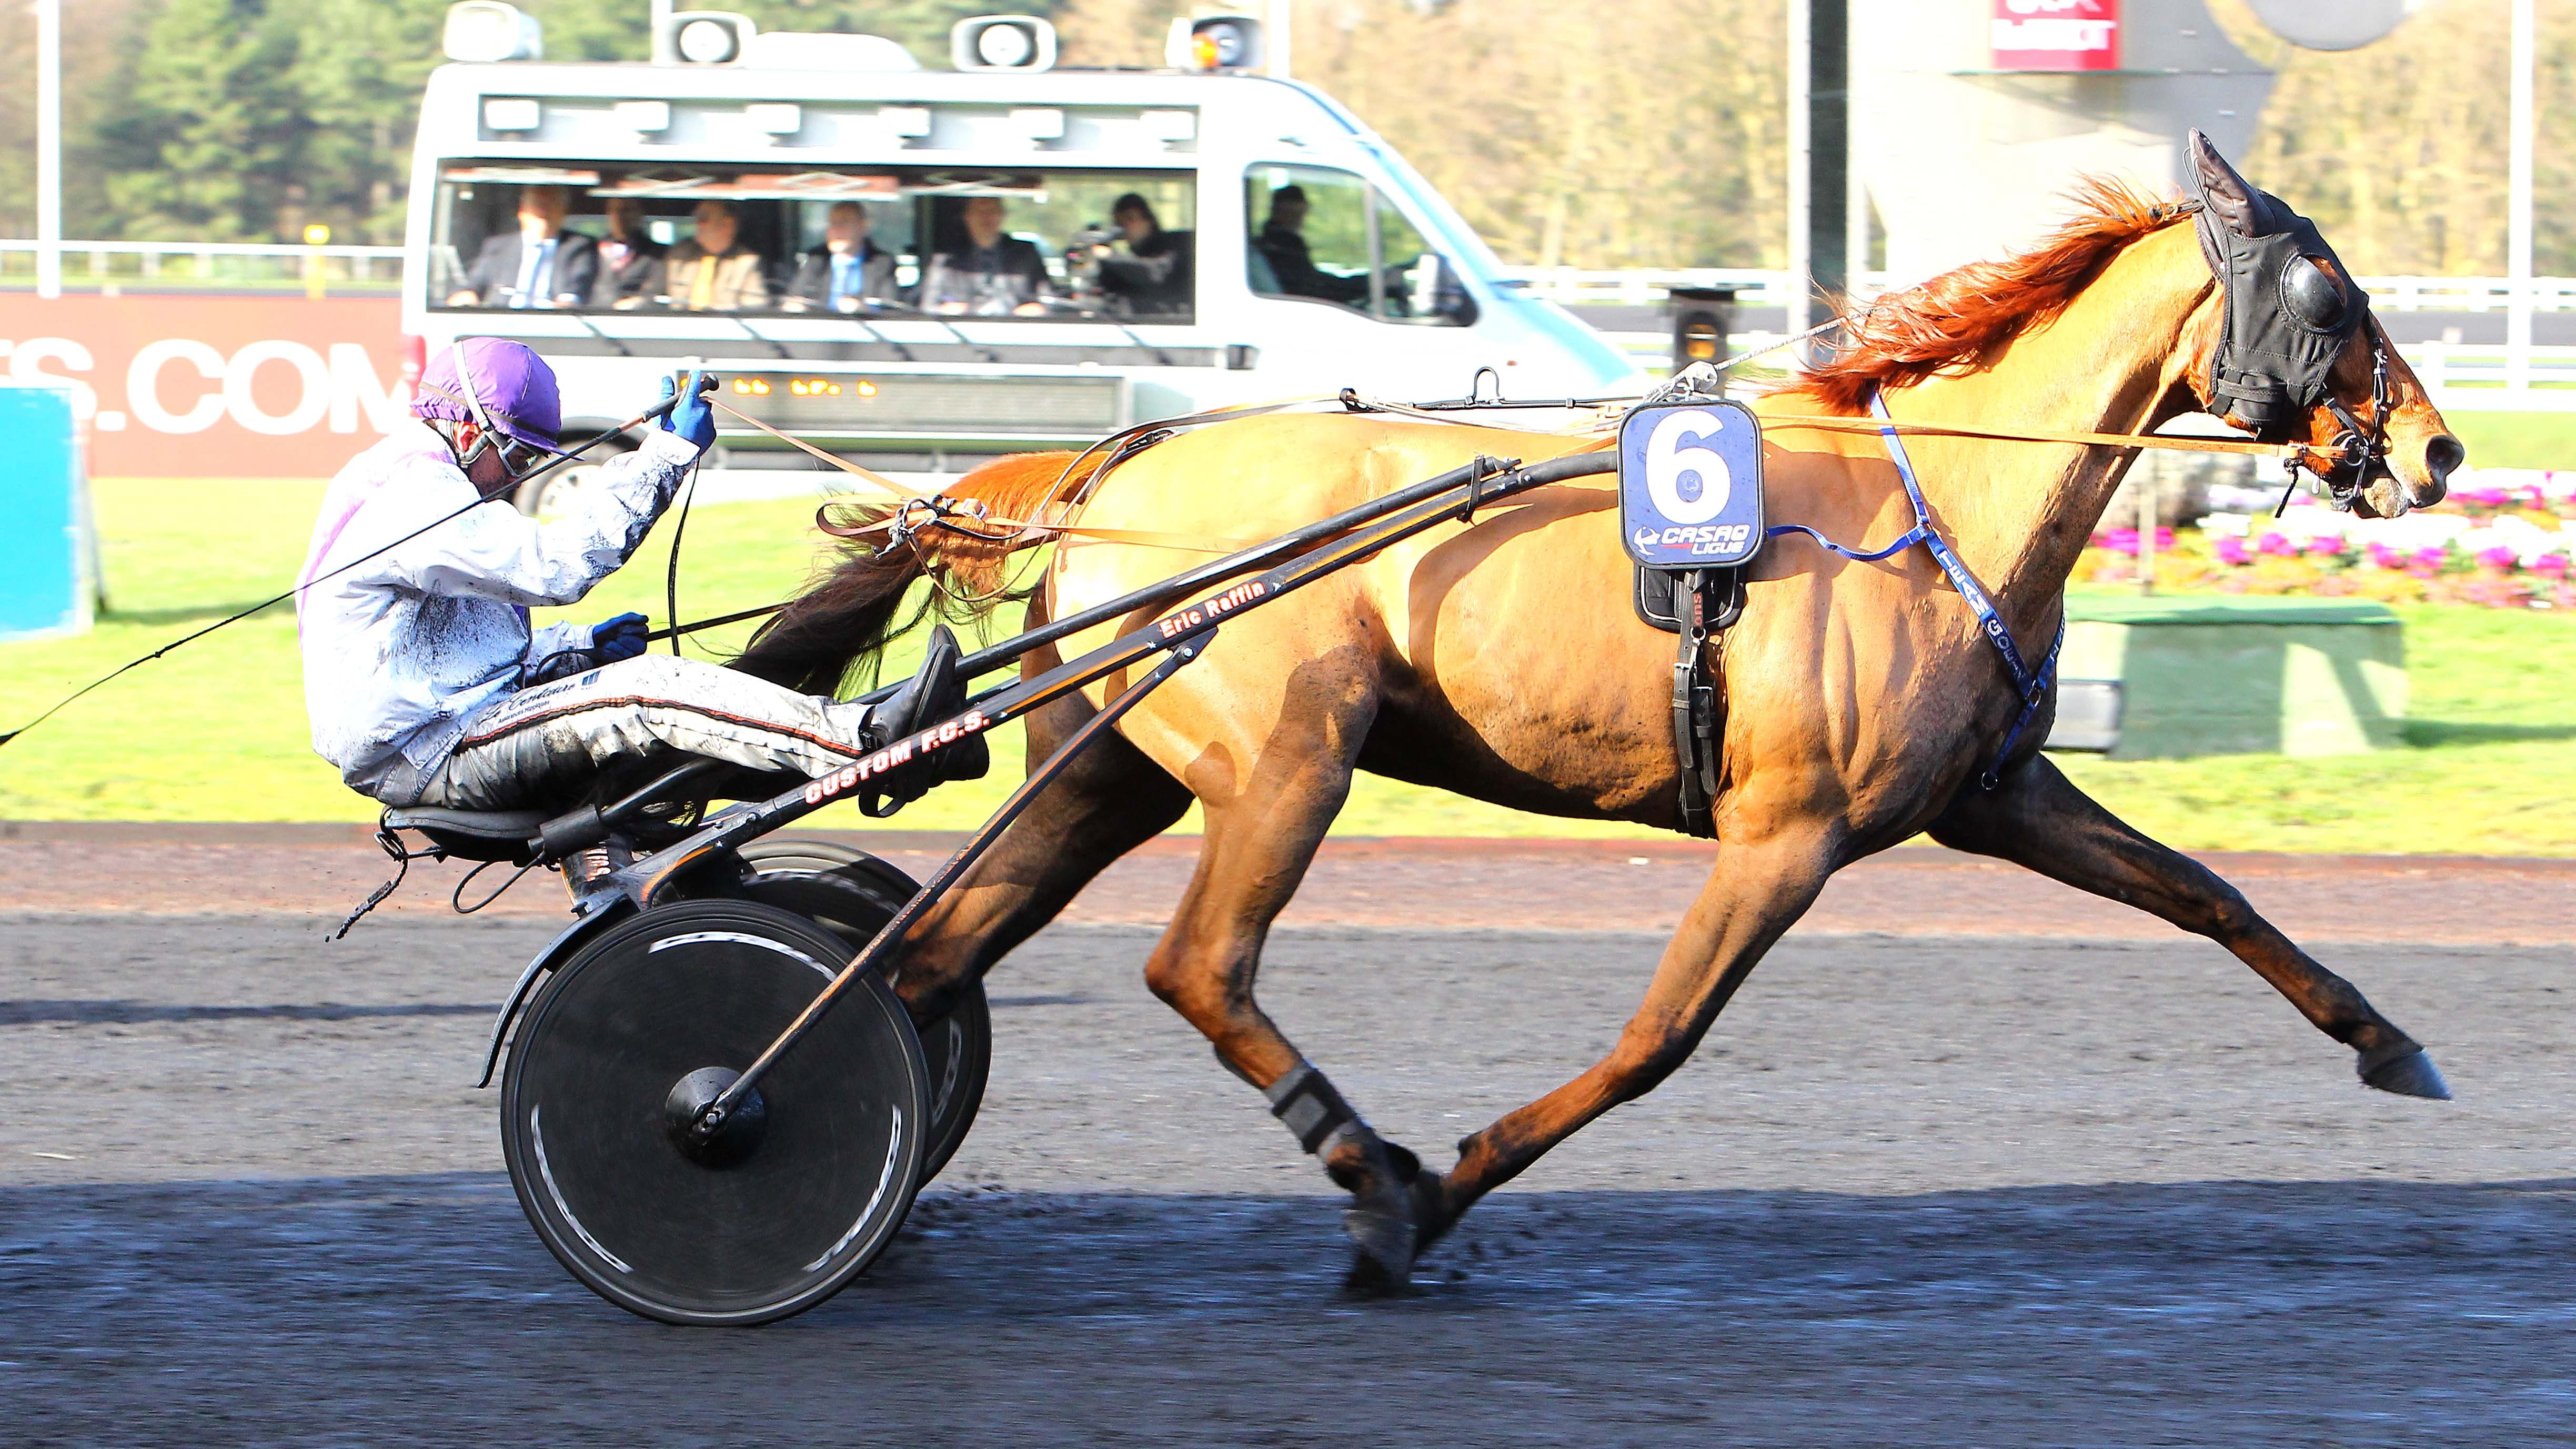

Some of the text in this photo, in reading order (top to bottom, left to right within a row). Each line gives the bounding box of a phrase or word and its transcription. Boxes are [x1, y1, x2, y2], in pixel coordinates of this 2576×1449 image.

[0, 337, 410, 435] S.COM
[1645, 409, 1731, 524] 6
[1691, 541, 1745, 555] LIGUE
[1159, 581, 1266, 639] Eric Raffin
[1938, 550, 1989, 616] TEAM
[509, 684, 576, 710] Centaure
[804, 710, 990, 804] CUSTOM F.C.S.
